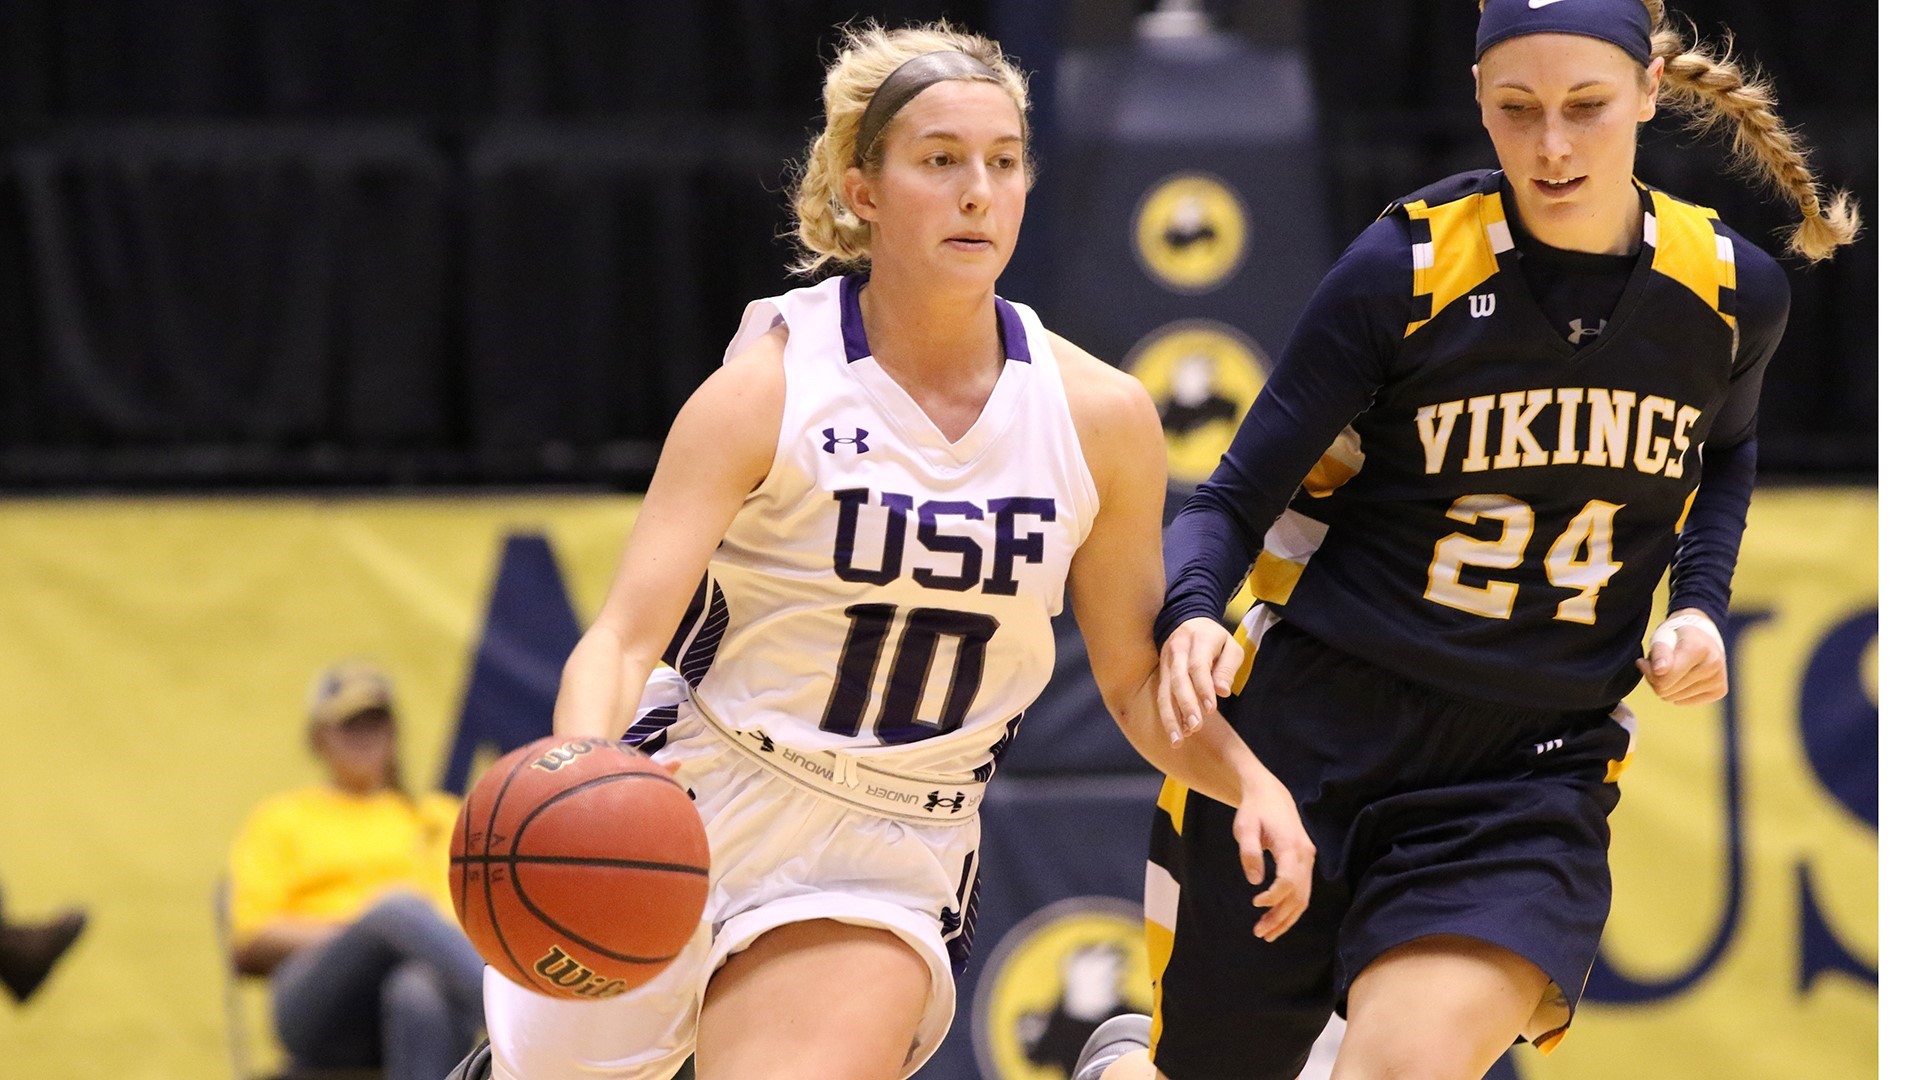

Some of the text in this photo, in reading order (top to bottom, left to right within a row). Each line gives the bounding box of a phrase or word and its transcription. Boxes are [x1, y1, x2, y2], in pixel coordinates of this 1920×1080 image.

[1413, 387, 1702, 479] VIKINGS
[833, 487, 1057, 597] USF
[1422, 493, 1627, 626] 24
[818, 602, 1001, 747] 10
[782, 747, 919, 805] UNDER MOUR
